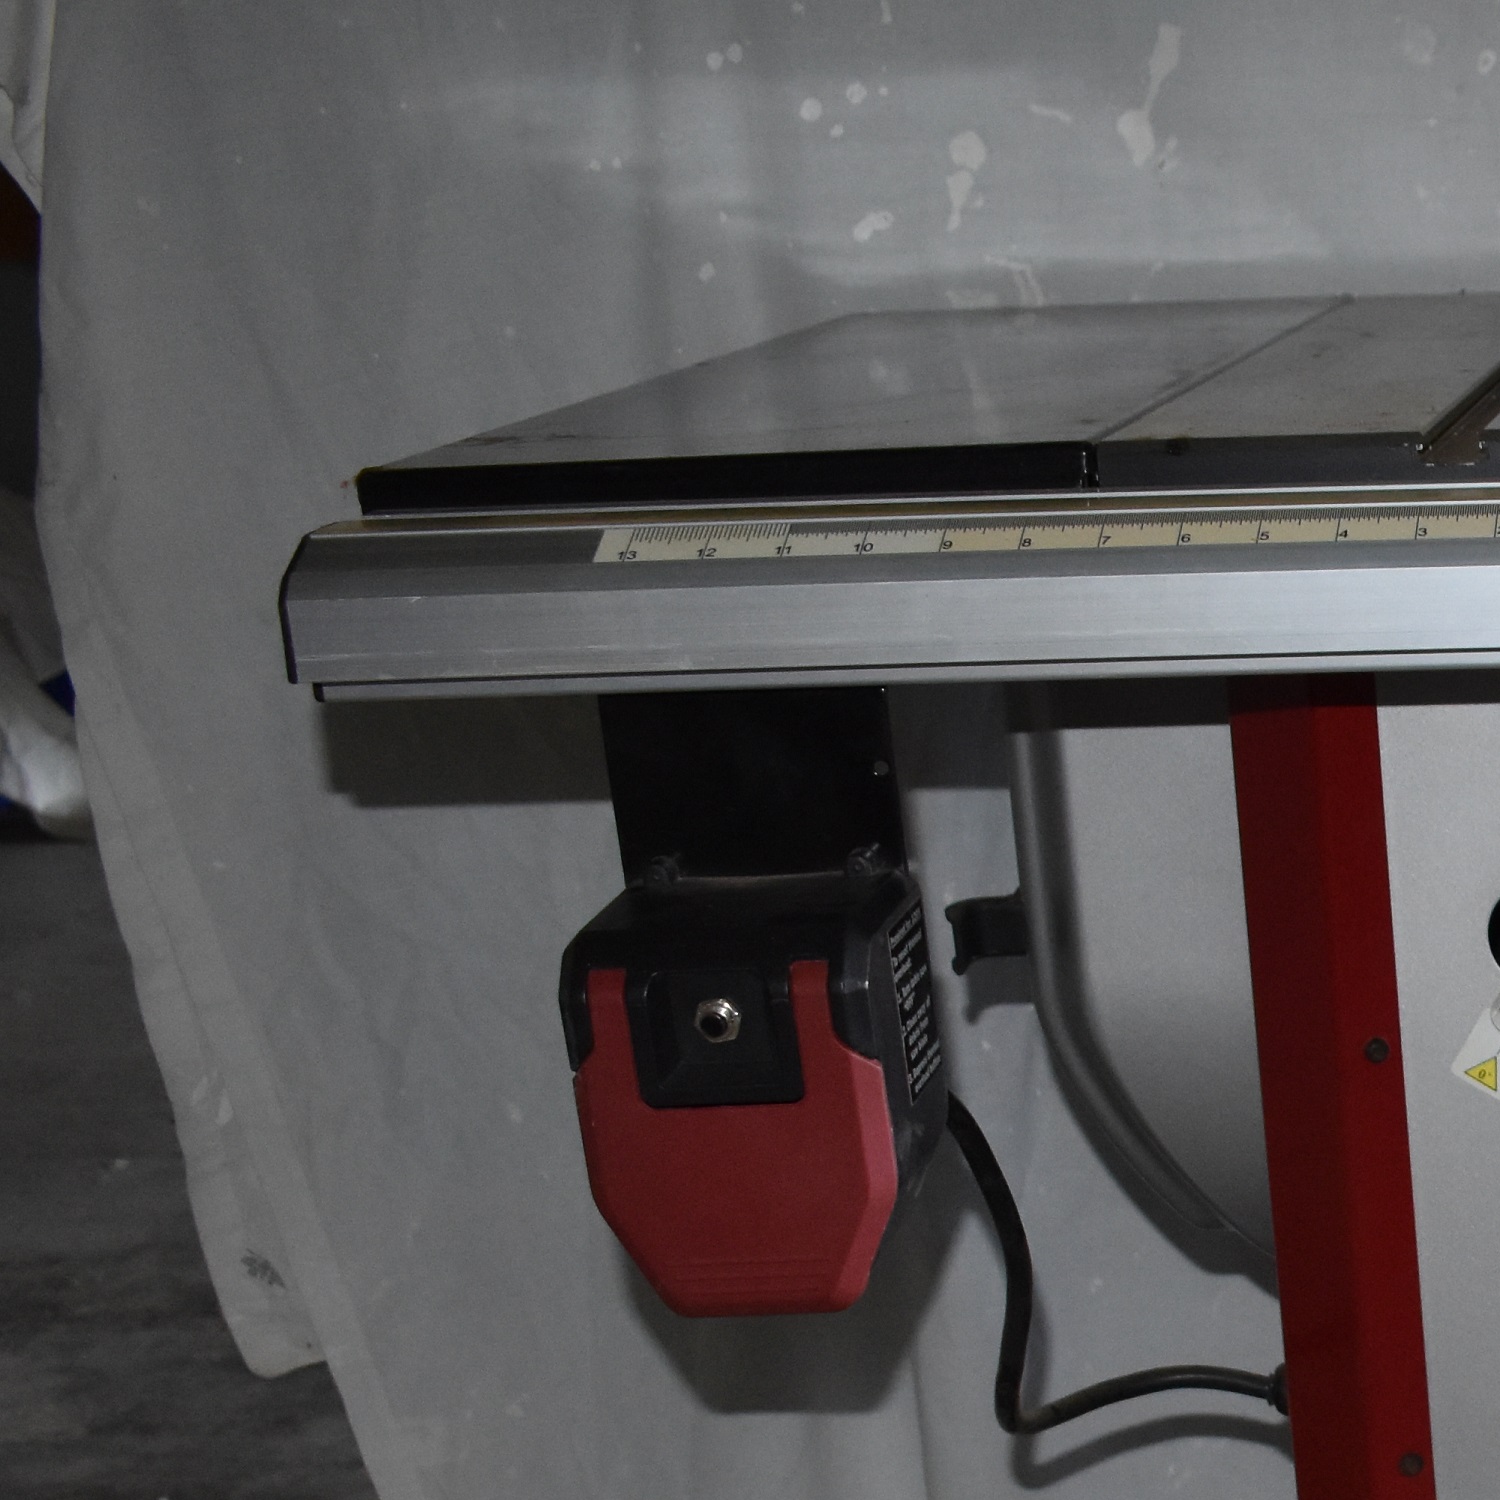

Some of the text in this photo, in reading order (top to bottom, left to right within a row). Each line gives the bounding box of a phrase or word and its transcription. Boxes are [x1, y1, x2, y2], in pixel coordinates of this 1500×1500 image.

[617, 550, 637, 560] 13
[696, 548, 717, 558] 12
[775, 545, 792, 555] 11
[854, 542, 874, 553] 10
